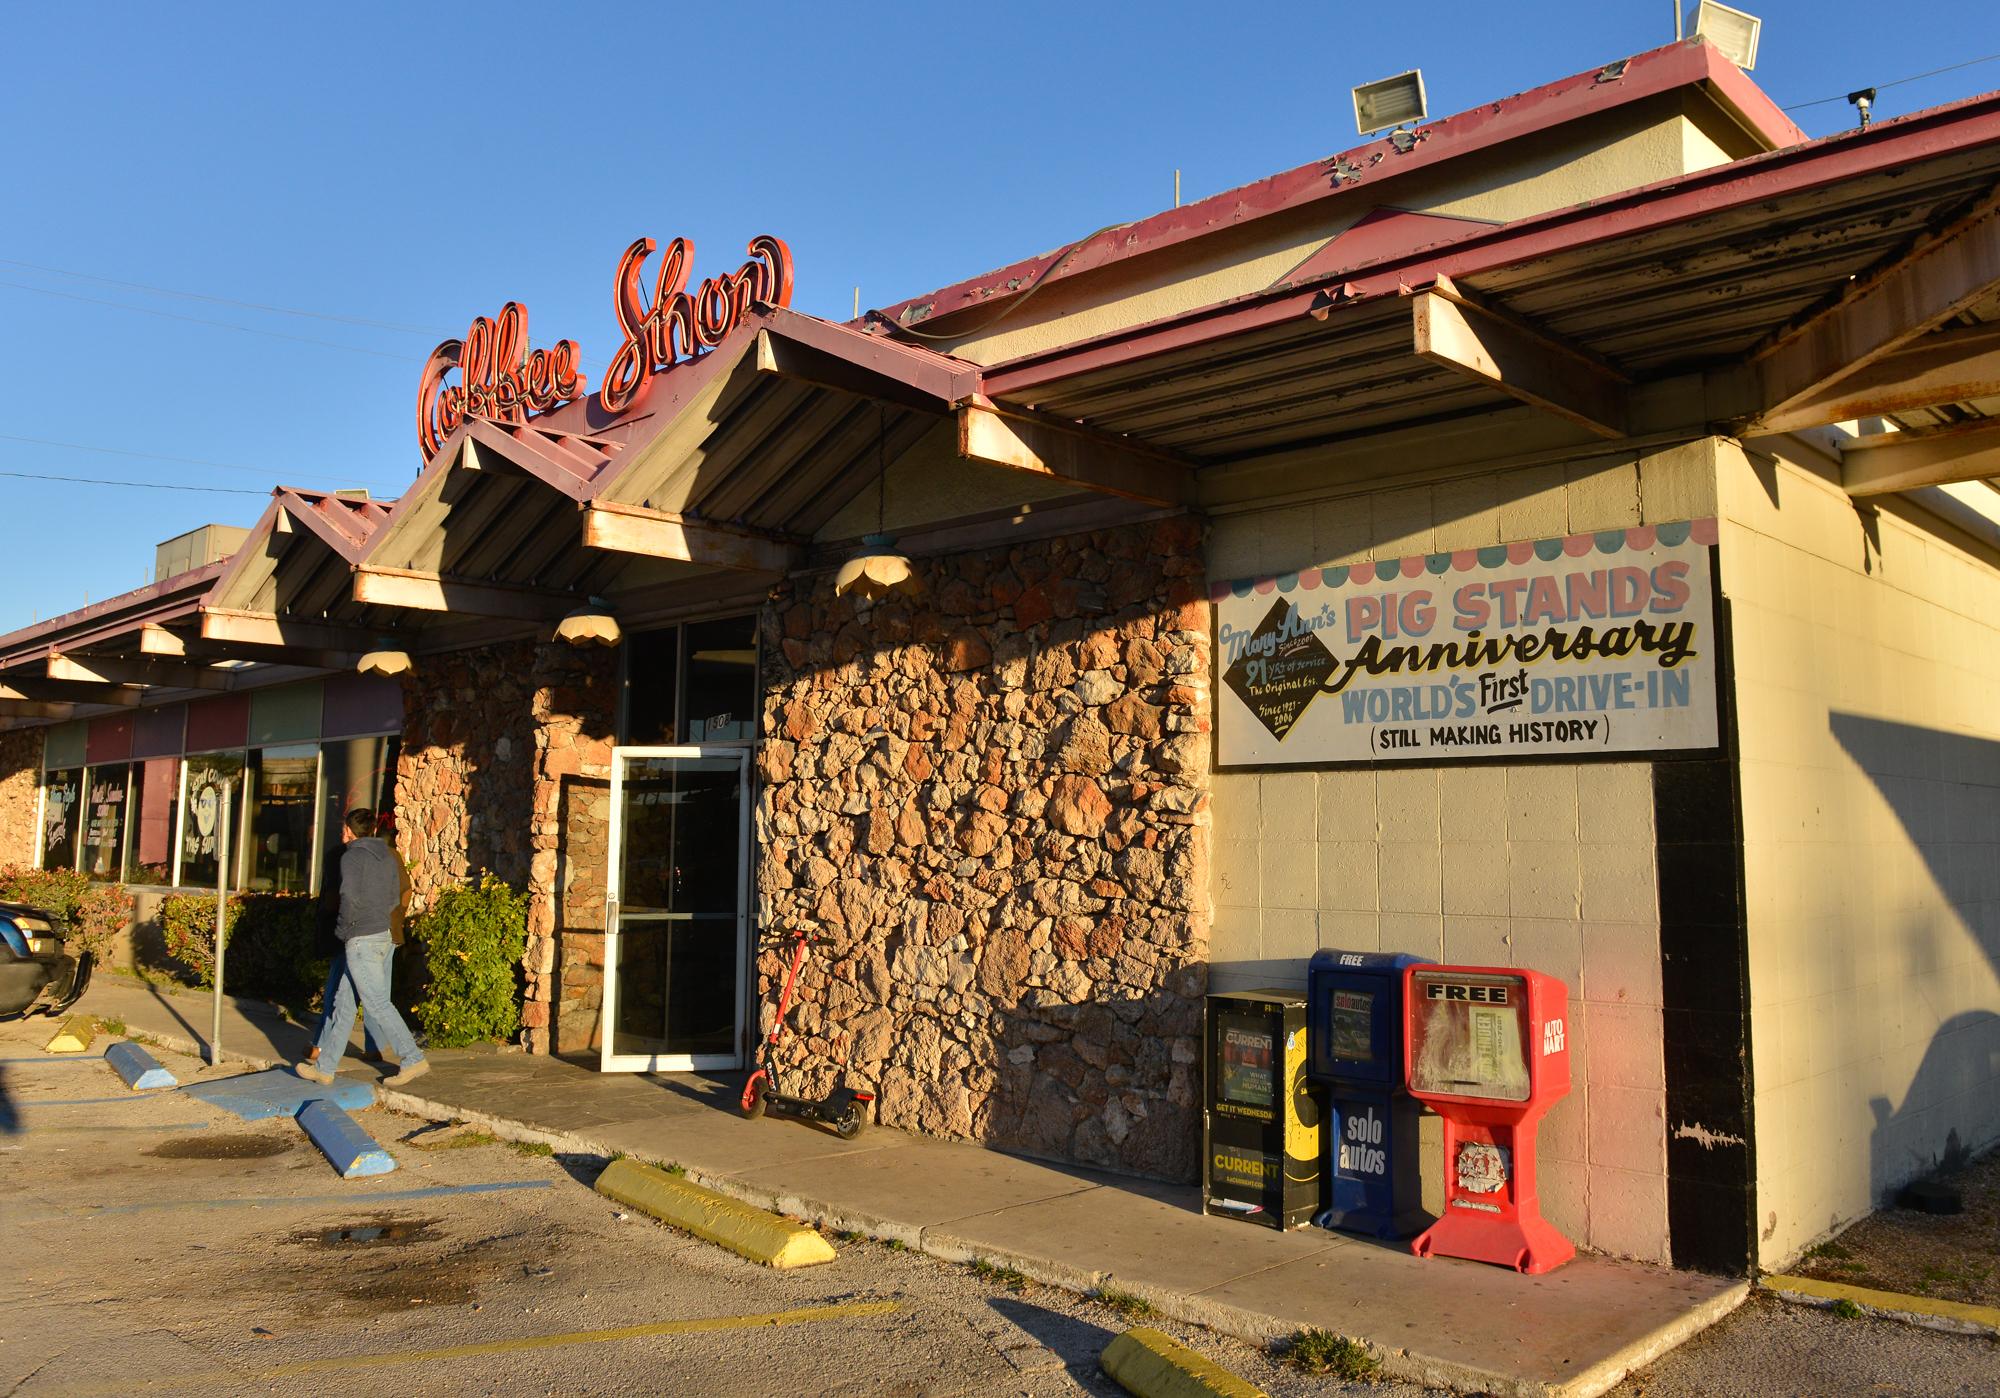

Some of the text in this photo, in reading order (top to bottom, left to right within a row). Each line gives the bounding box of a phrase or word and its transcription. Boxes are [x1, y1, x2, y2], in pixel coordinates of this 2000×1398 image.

[416, 301, 588, 466] Coffee
[1345, 560, 1691, 644] PIG STANDS
[1219, 601, 1336, 665] Mary Ann's
[1317, 618, 1699, 694] Anniversary
[1245, 658, 1267, 689] 91
[1249, 685, 1263, 696] The
[1265, 677, 1301, 696] Original
[1341, 667, 1691, 724] WORLD'S First DRIVE-IN
[1259, 705, 1282, 718] Since
[1274, 711, 1293, 726] 2006
[1429, 724, 1501, 746] MAKING
[1339, 954, 1364, 967] FREE
[1428, 984, 1507, 1003] FREE
[1545, 1019, 1563, 1037] AUTO
[1226, 1032, 1272, 1050] CURRENT
[1544, 1034, 1565, 1057] MART
[1216, 1103, 1229, 1112] GET
[1236, 1106, 1277, 1119] WEDNESDAY
[1347, 1107, 1382, 1144] solo
[1214, 1154, 1280, 1180] CURRENT
[1339, 1144, 1385, 1175] autos
